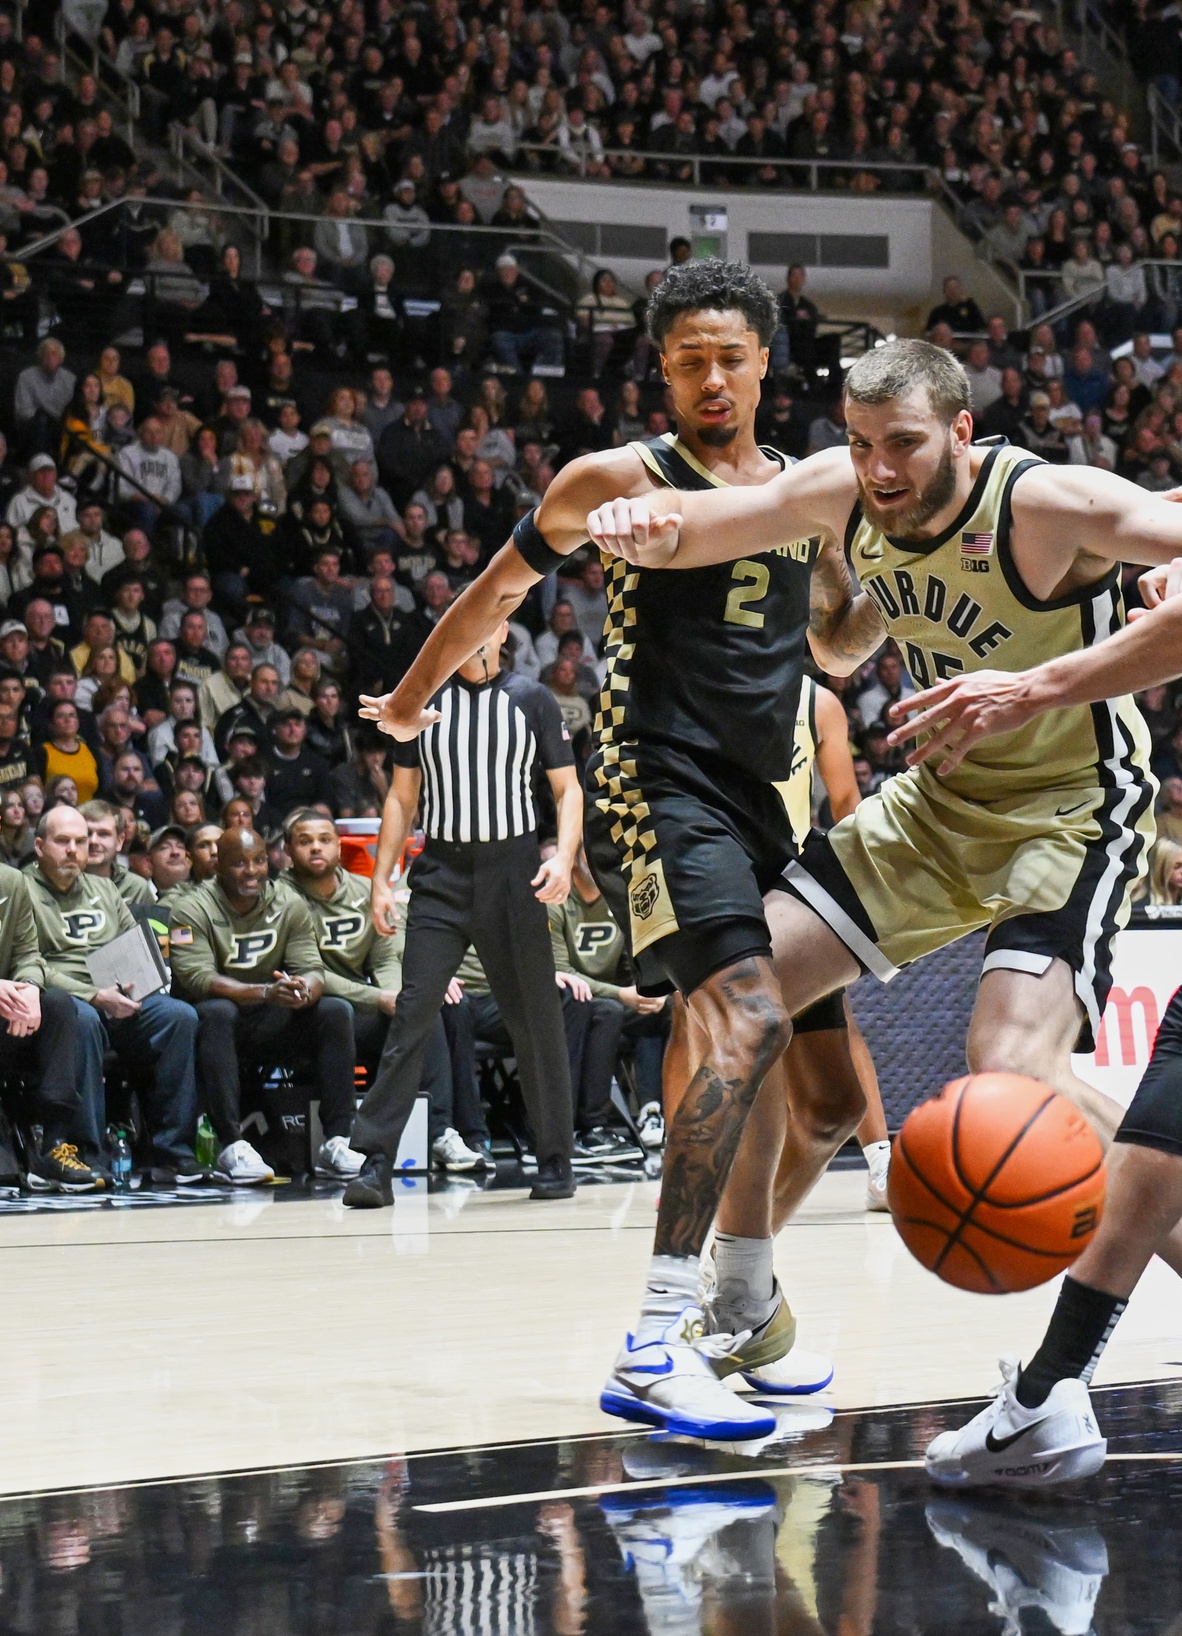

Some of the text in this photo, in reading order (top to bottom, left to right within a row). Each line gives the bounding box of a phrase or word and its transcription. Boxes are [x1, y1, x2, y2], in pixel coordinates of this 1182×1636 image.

[961, 558, 990, 573] BIG
[723, 560, 770, 629] 2
[865, 568, 1015, 660] URDUE
[61, 909, 106, 944] P
[320, 912, 365, 950] P
[575, 921, 617, 956] P
[224, 929, 278, 969] P
